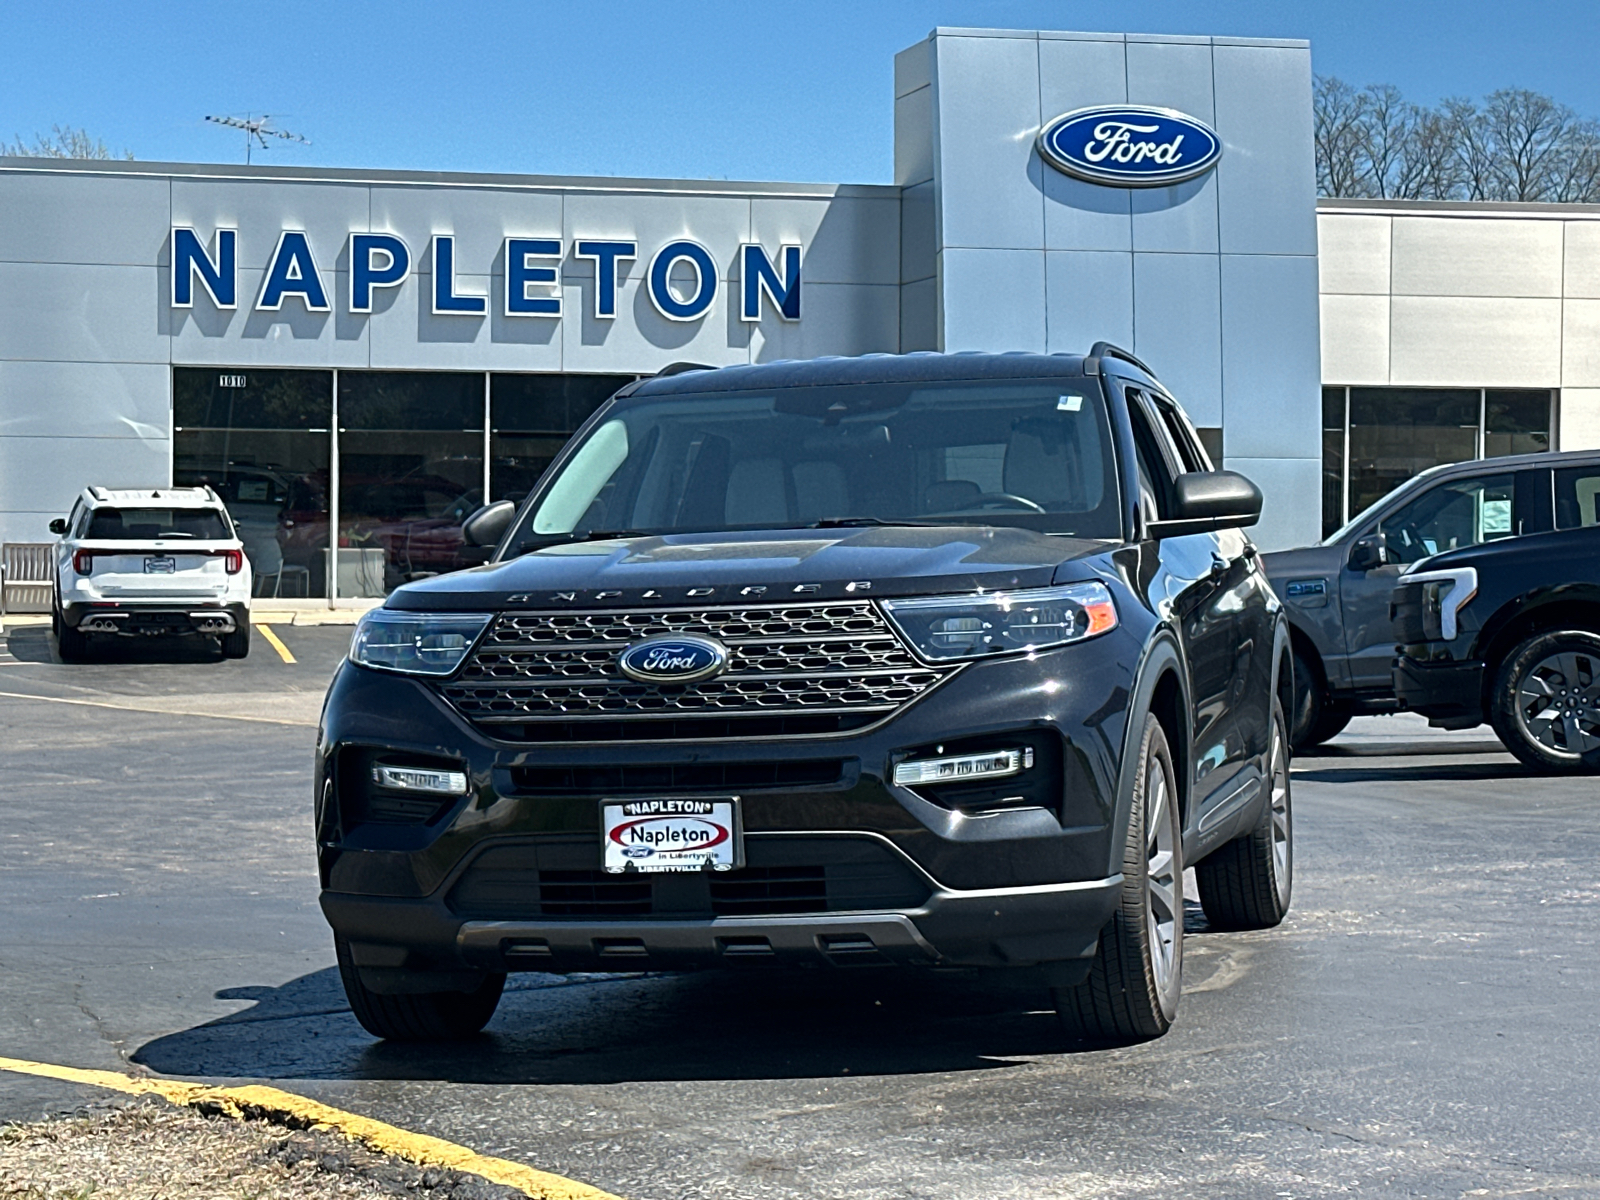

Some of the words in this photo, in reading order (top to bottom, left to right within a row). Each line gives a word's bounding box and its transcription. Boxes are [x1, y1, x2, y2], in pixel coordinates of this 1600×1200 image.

[1084, 121, 1185, 165] Ford
[171, 226, 803, 322] NAPLETON
[221, 375, 246, 388] 1010
[506, 580, 872, 603] EXPLORER
[643, 647, 697, 670] Ford
[631, 800, 705, 815] NAPLETON
[630, 826, 710, 846] Napleton
[626, 848, 650, 857] Ford
